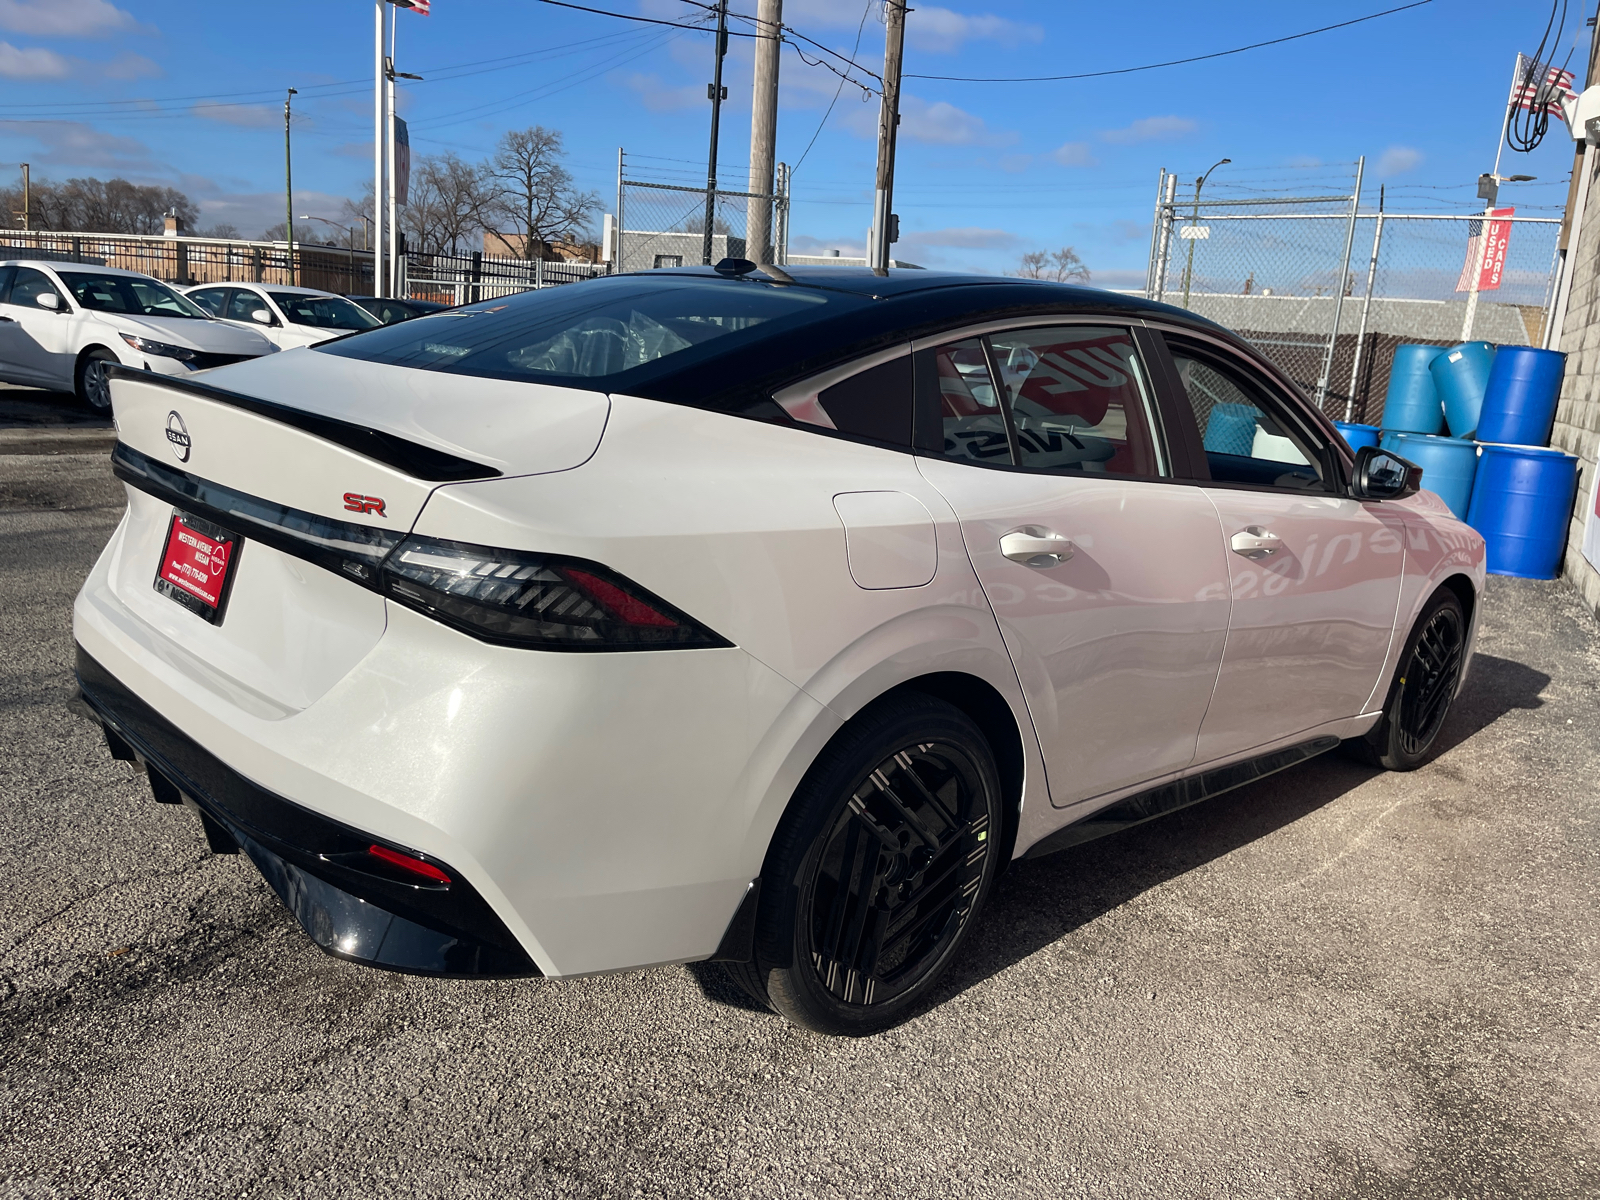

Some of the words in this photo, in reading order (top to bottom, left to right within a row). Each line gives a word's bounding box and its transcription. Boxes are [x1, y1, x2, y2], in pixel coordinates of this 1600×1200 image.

[1484, 224, 1499, 269] USED
[1491, 238, 1506, 284] CARS
[343, 492, 388, 518] SR
[178, 531, 198, 549] WESTERN
[196, 540, 213, 555] AVENUE
[195, 551, 210, 566] NISSAN
